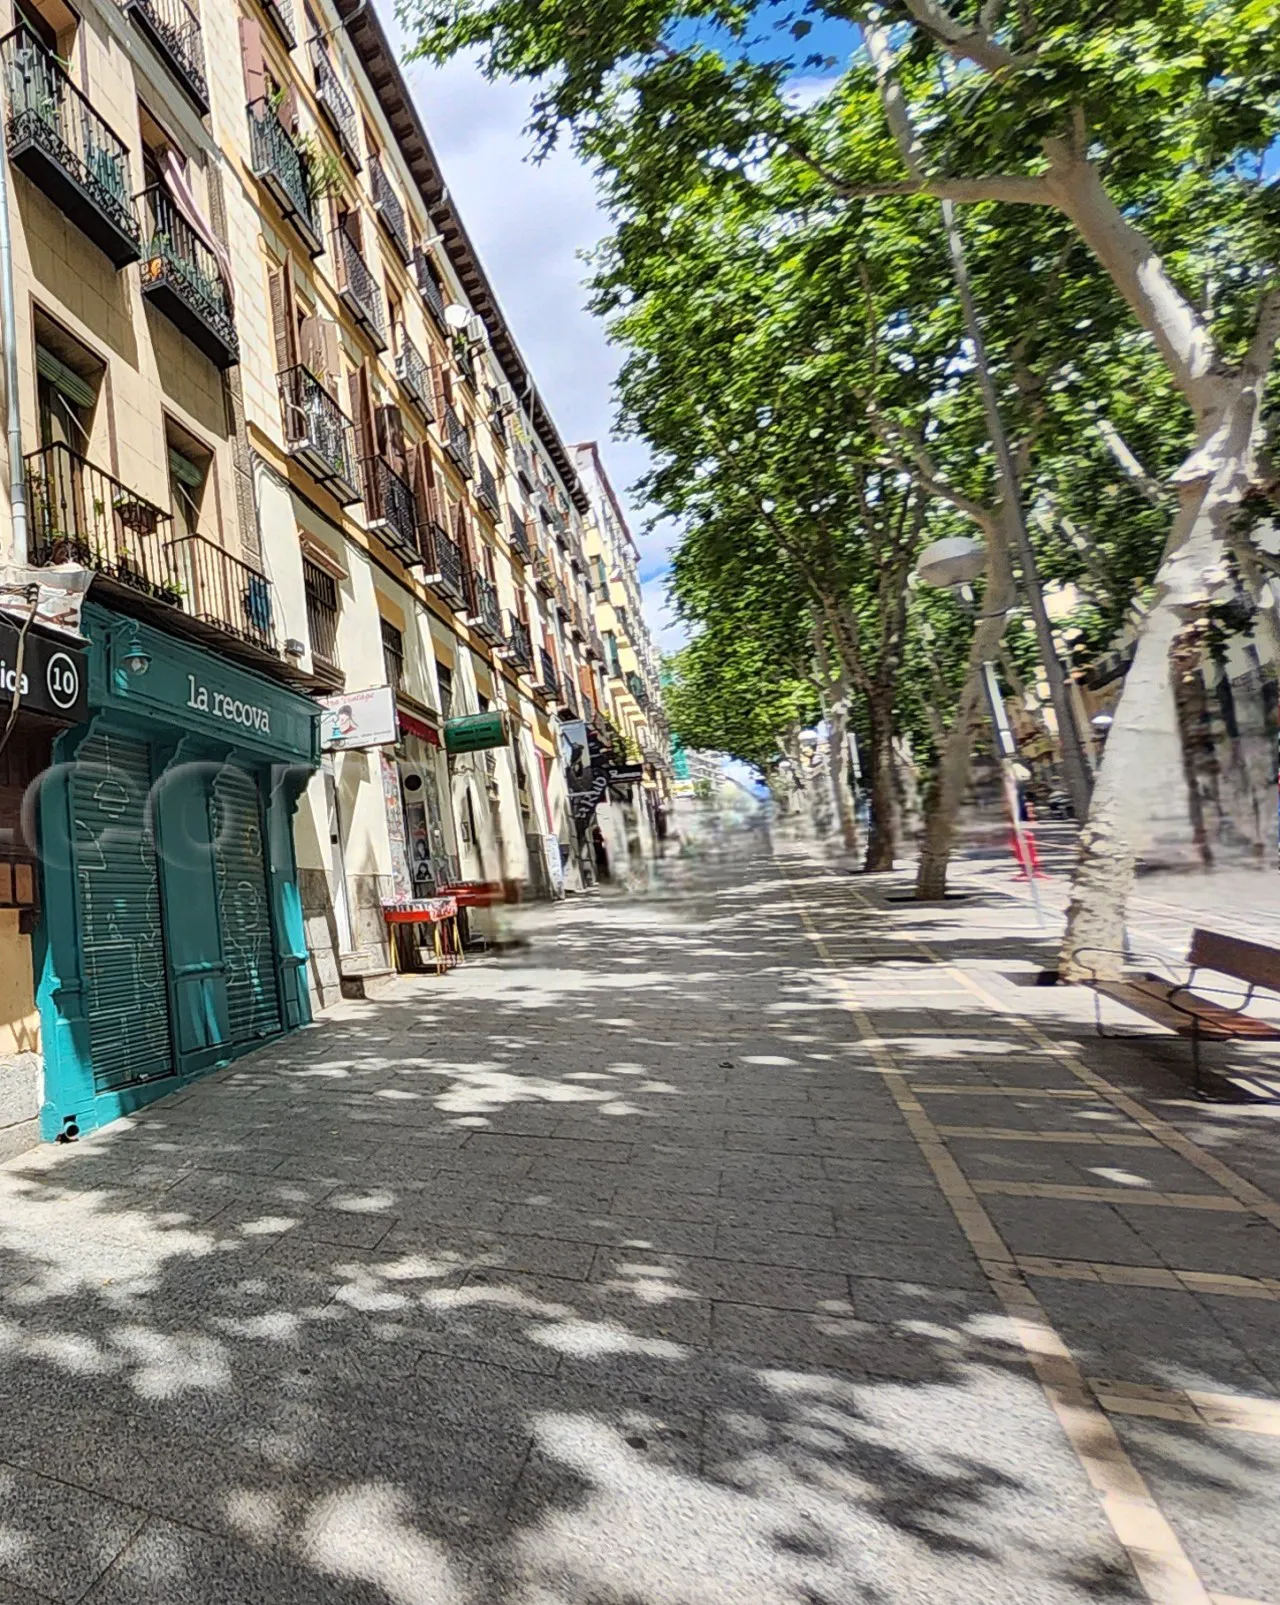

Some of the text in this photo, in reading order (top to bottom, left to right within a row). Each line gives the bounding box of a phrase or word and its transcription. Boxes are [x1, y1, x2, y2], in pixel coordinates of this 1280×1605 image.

[52, 667, 75, 695] 10
[187, 674, 271, 734] la recova
